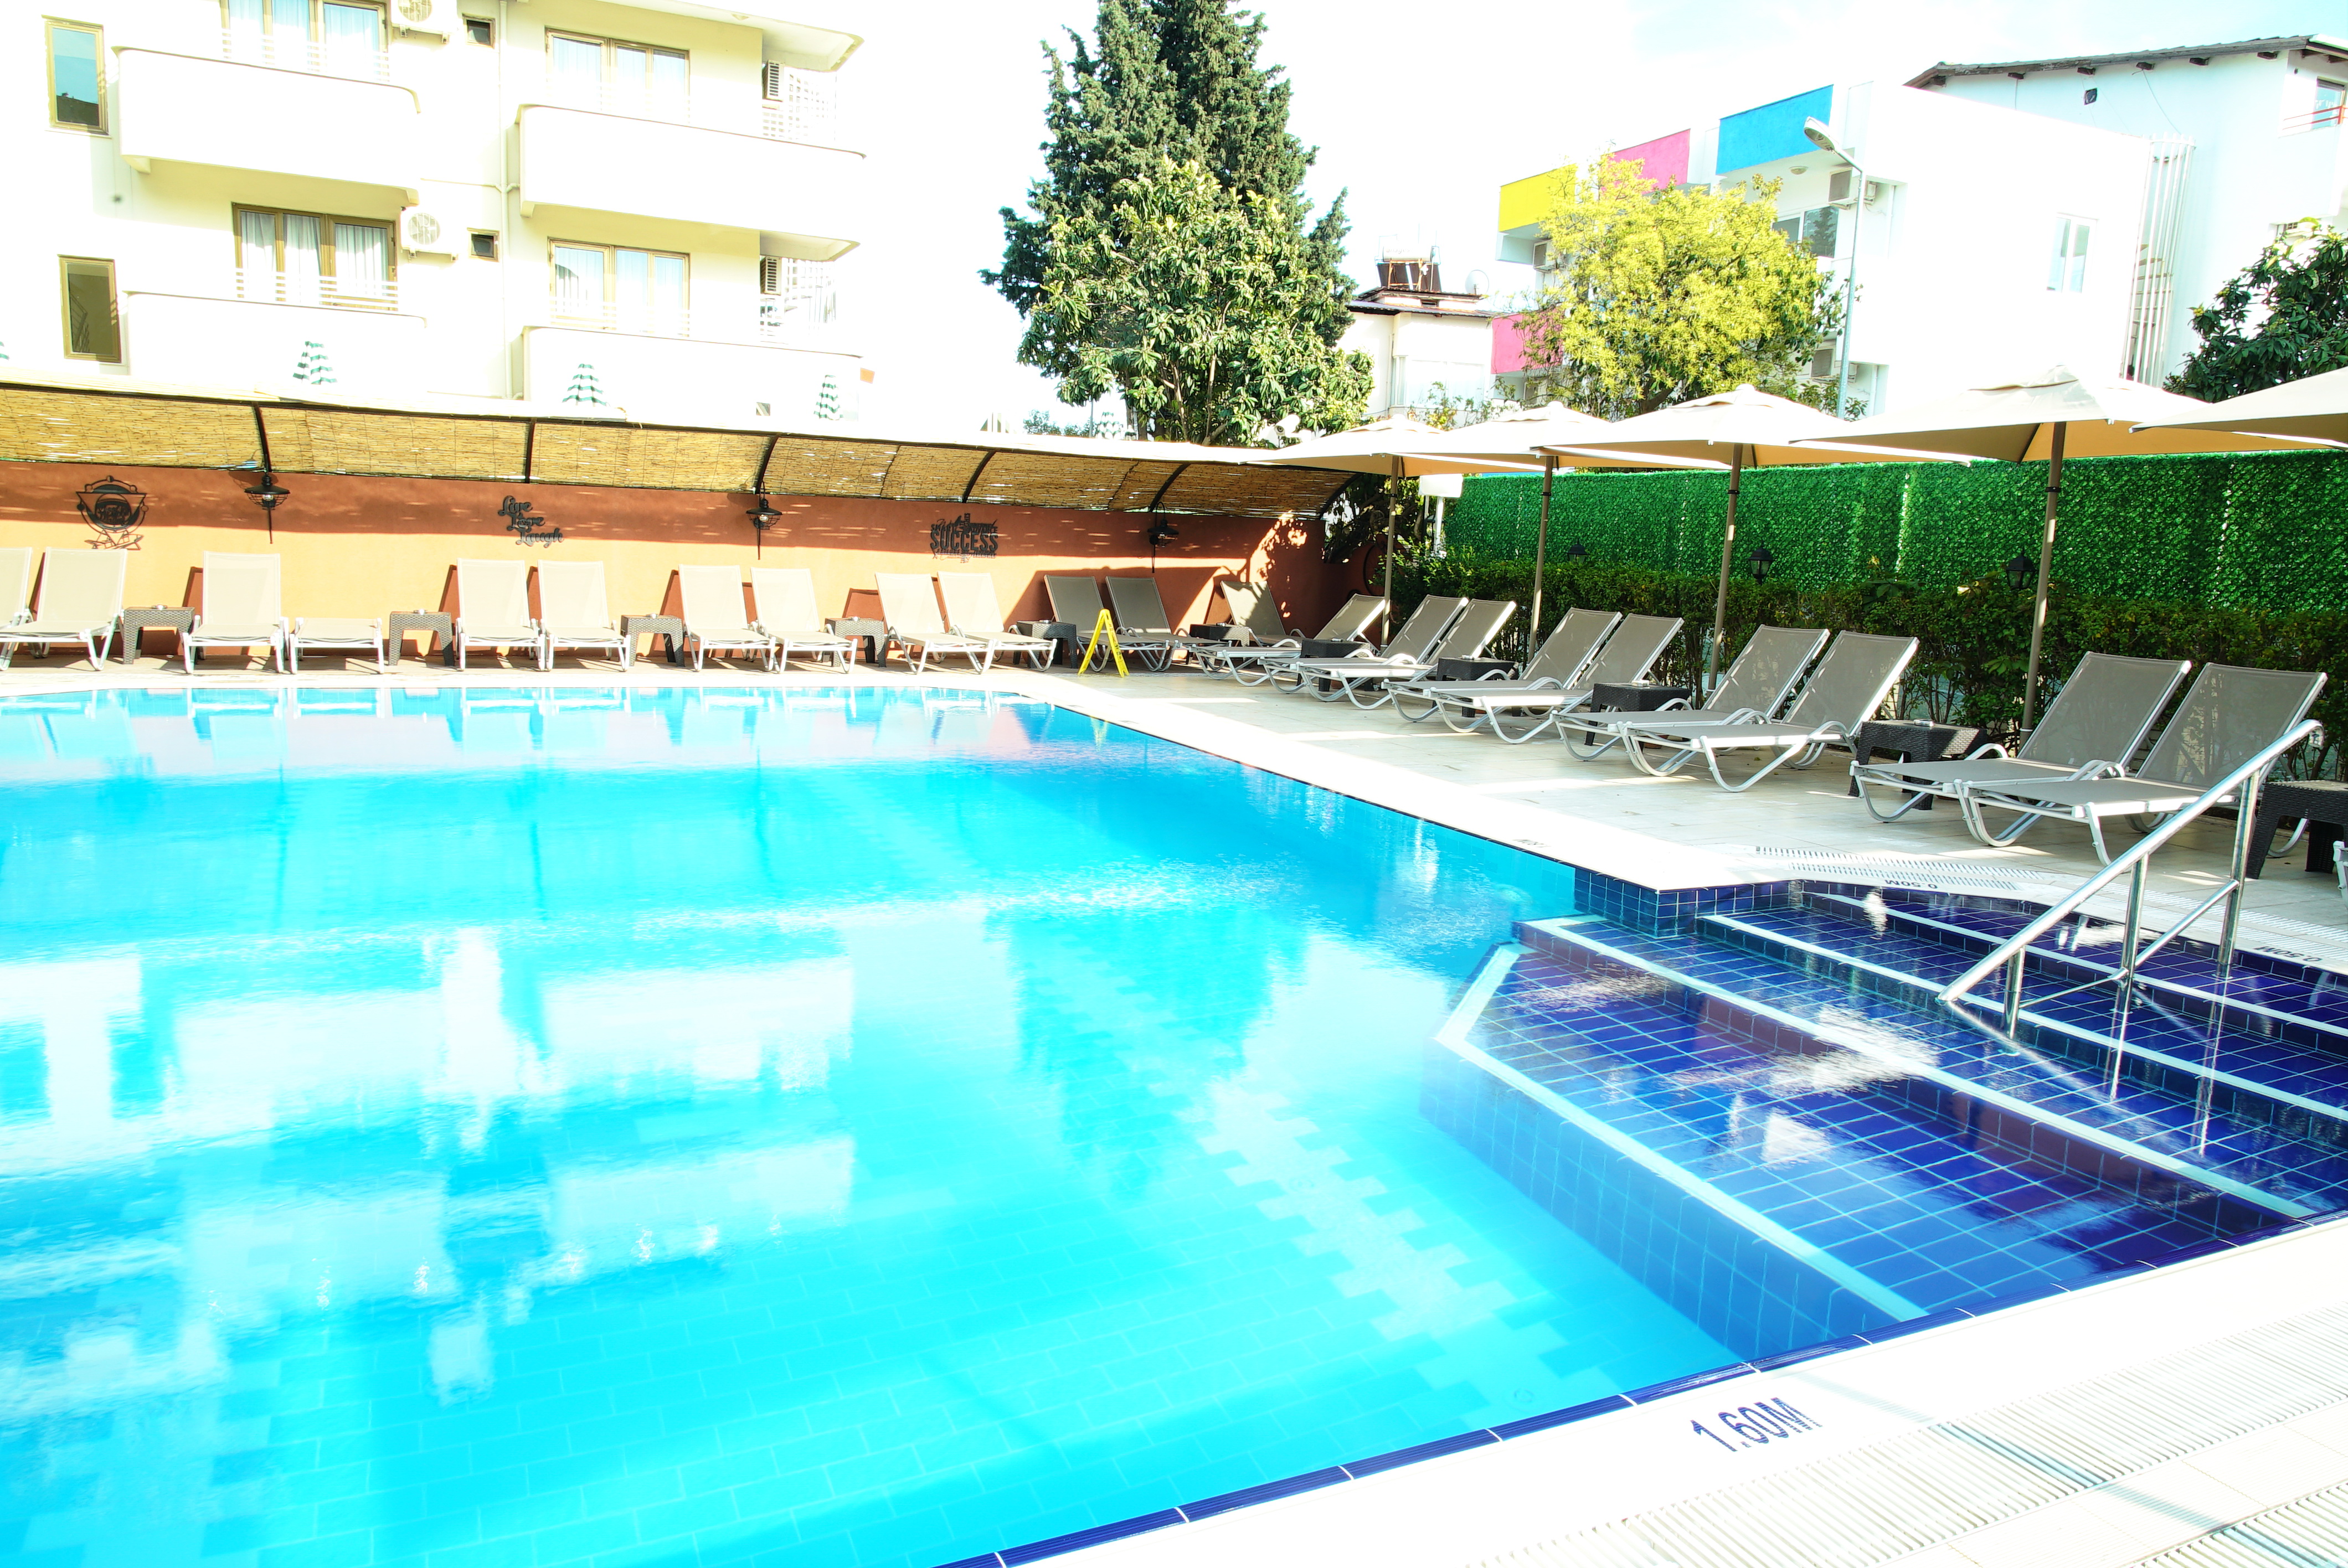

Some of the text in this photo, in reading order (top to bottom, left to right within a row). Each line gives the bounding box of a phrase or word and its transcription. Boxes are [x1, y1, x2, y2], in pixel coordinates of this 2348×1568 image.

[498, 495, 533, 516] Live
[507, 512, 545, 533] Love
[516, 527, 564, 548] Laugh
[930, 529, 998, 553] SUCCESS
[2253, 946, 2323, 962] 0.50M
[1690, 1397, 1824, 1452] 1.60M
